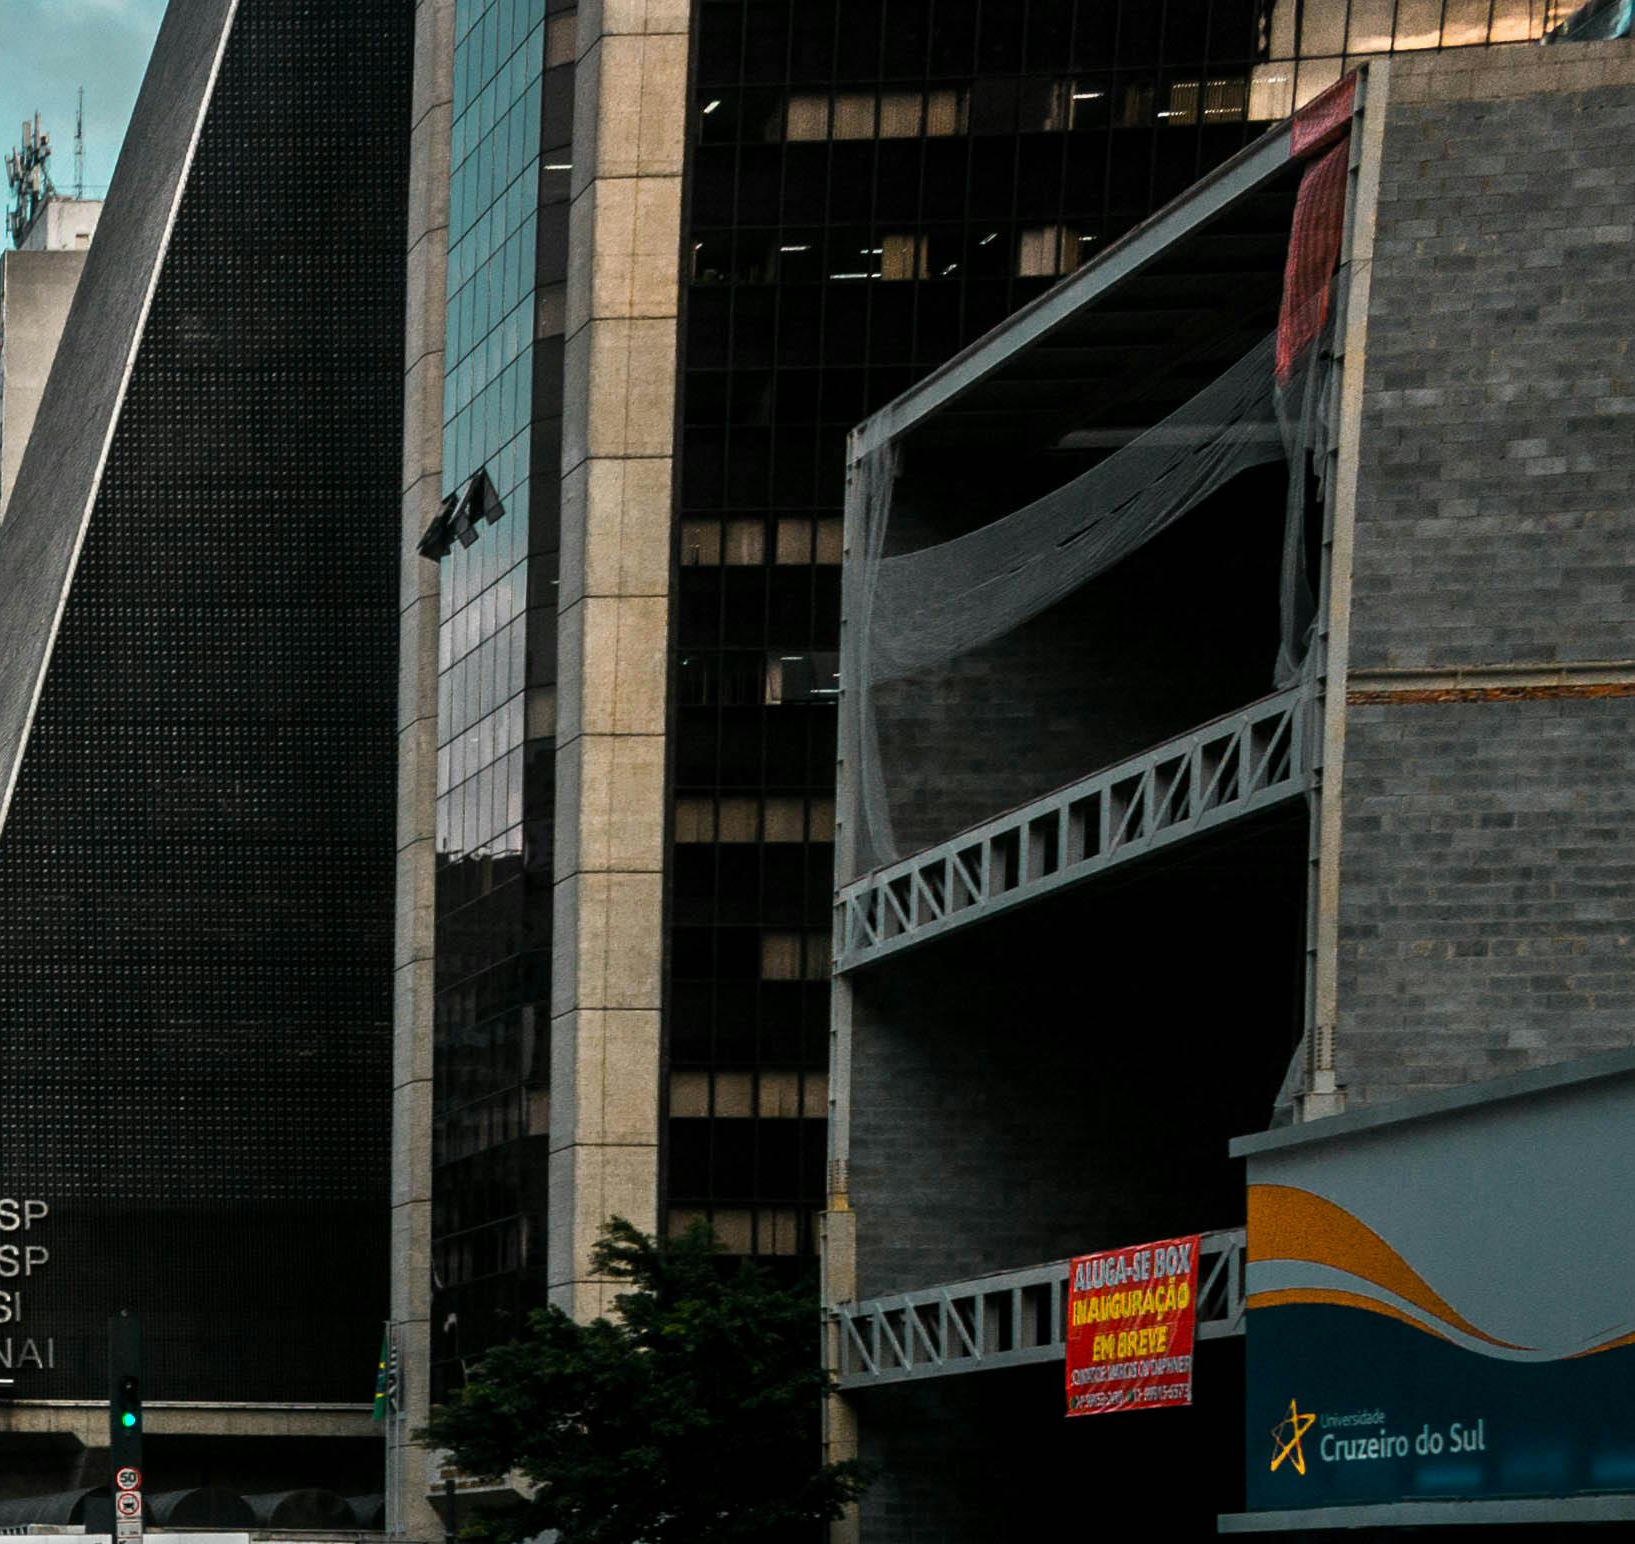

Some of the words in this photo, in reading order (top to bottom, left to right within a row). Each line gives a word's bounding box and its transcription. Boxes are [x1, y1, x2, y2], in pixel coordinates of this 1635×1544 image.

[1073, 1250, 1151, 1292] ALUGA-SE
[1153, 1242, 1192, 1279] BOX
[1073, 1276, 1190, 1326] INAUGURAÇÃO
[1092, 1333, 1116, 1361] EM
[1117, 1326, 1168, 1358] BREVE
[1321, 1408, 1385, 1428] Universidade
[1320, 1428, 1408, 1462] Cruzeiro
[1415, 1424, 1443, 1455] do
[1449, 1418, 1485, 1452] Sul
[119, 1471, 137, 1483] 50
